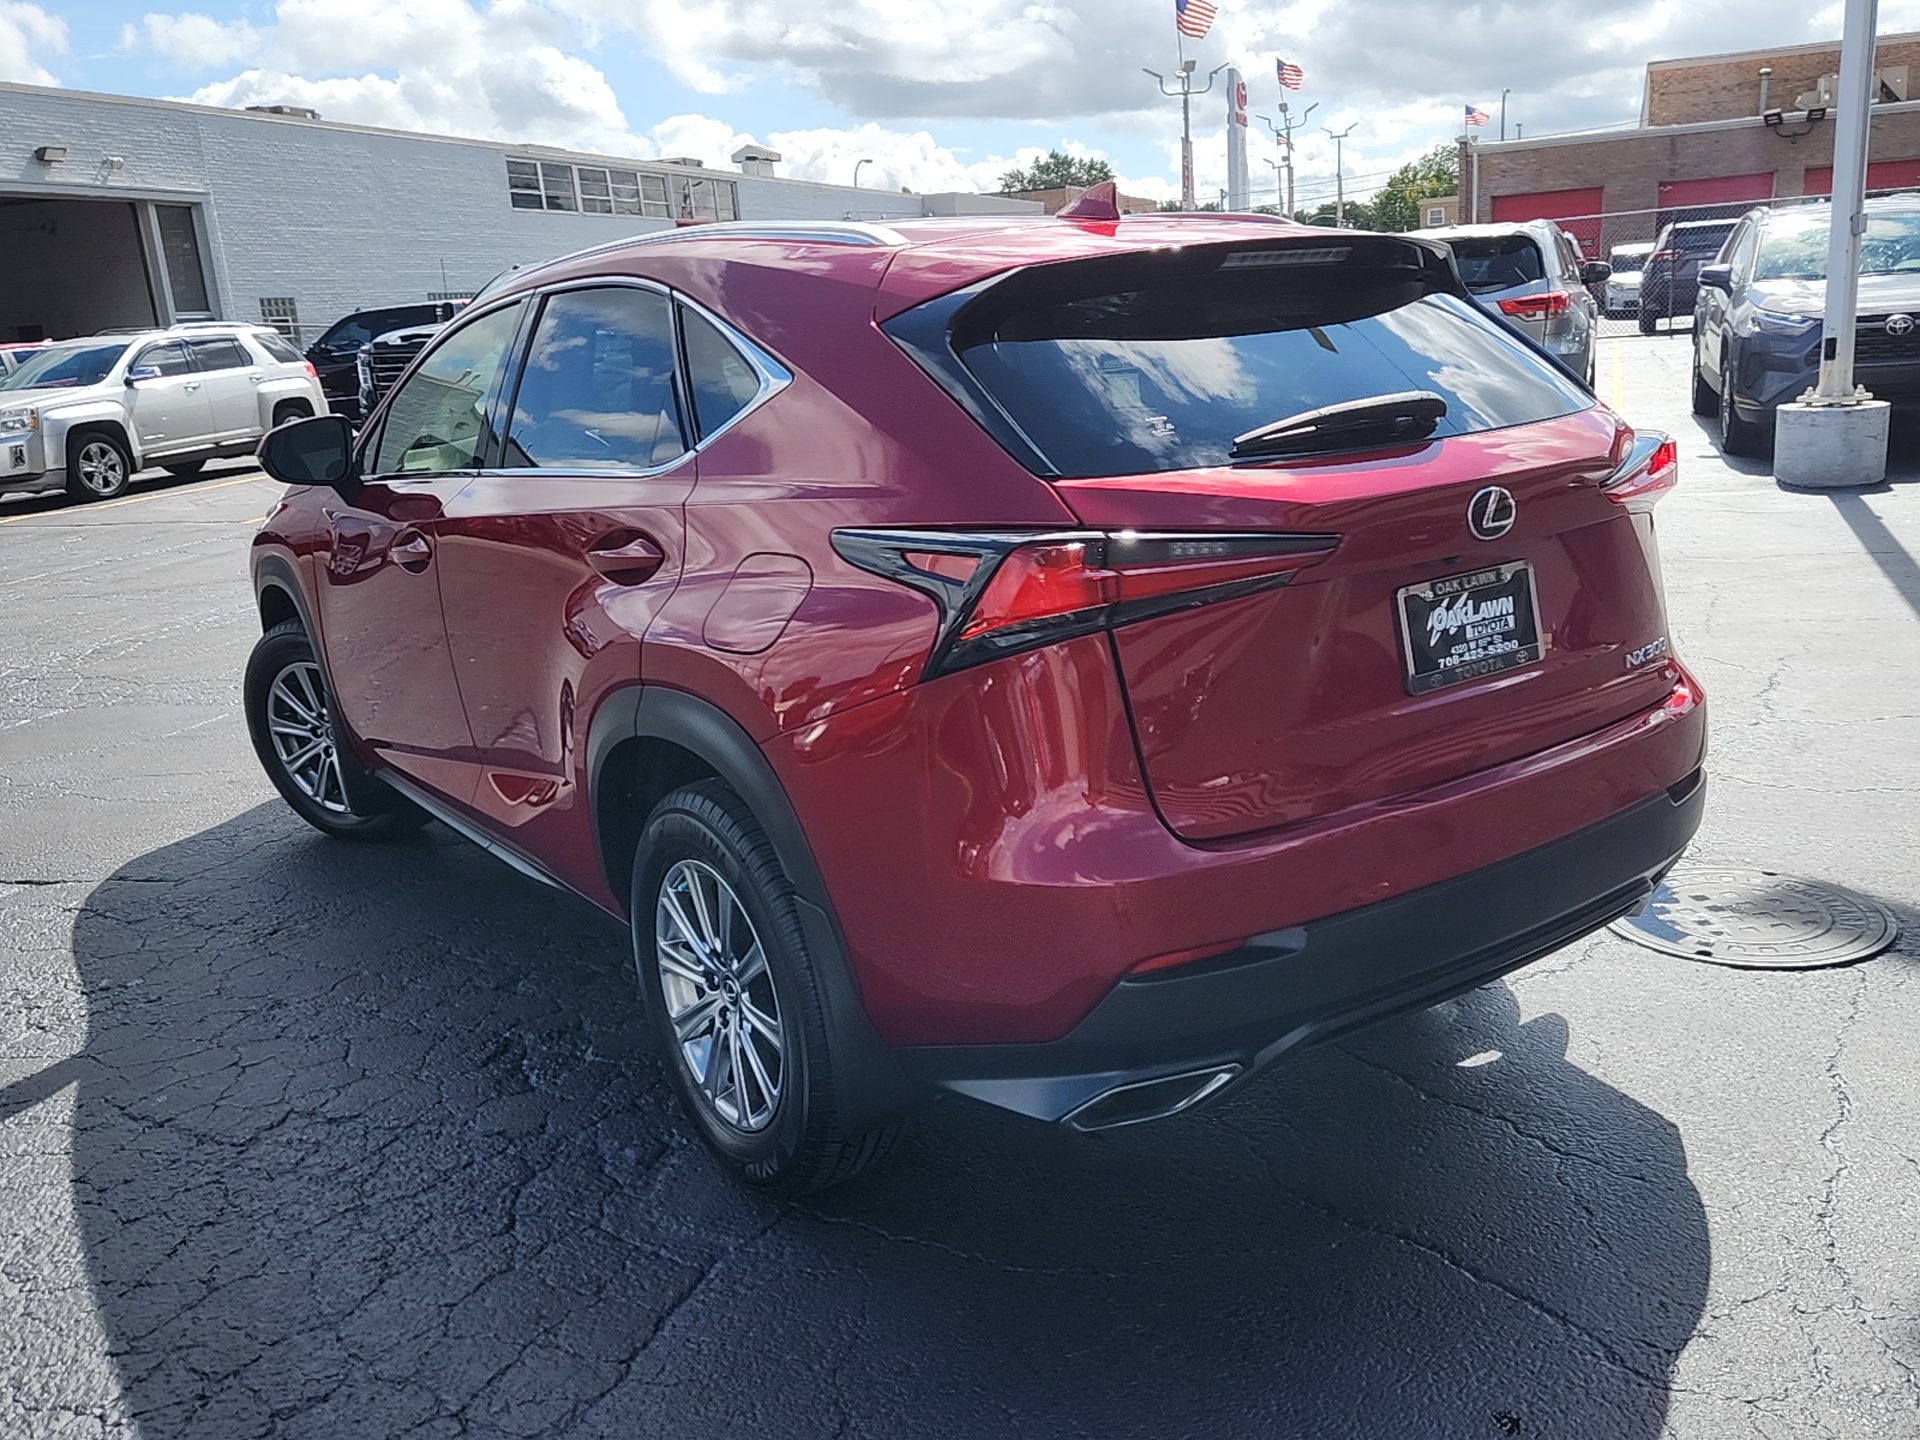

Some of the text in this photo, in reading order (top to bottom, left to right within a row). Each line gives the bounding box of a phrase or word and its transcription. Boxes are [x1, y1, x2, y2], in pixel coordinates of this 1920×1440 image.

[1435, 569, 1498, 596] OAK LAWN
[1471, 617, 1511, 637] TOYOTA
[1455, 659, 1505, 680] TOYOTA
